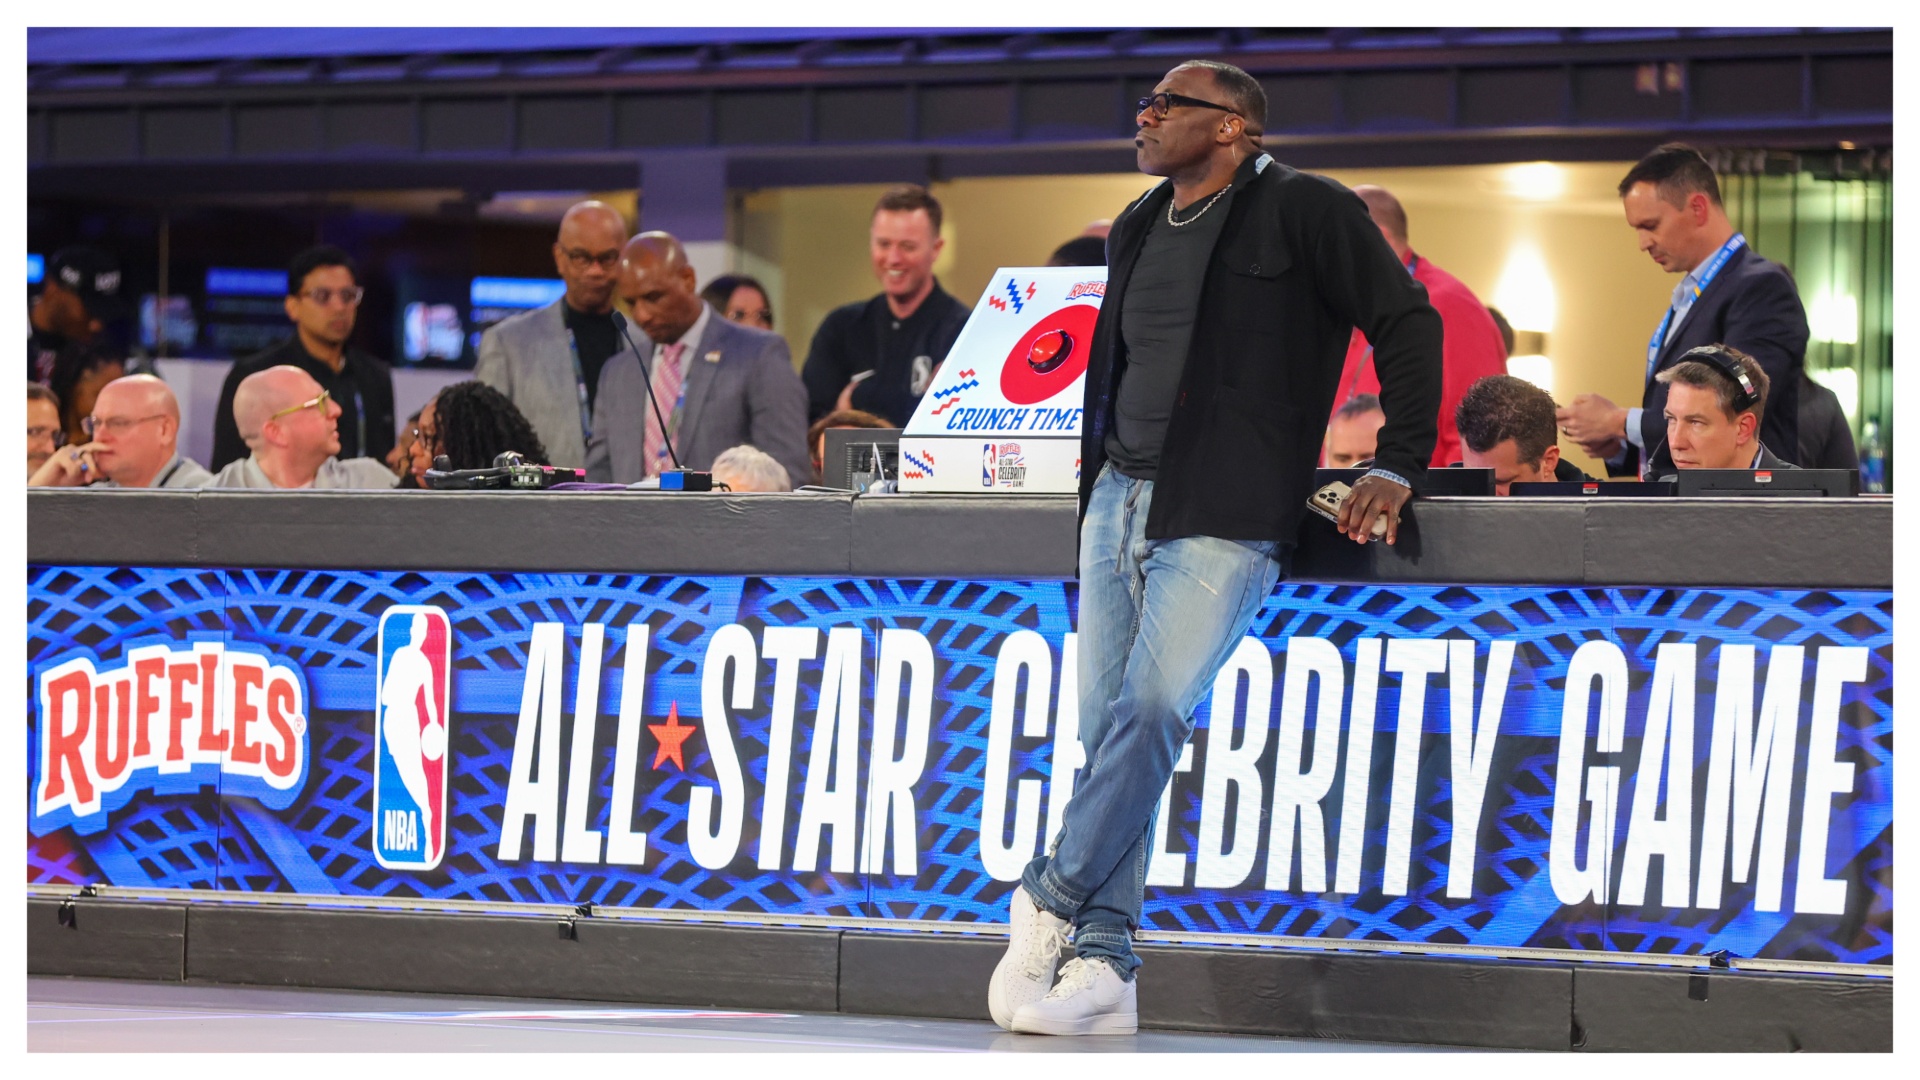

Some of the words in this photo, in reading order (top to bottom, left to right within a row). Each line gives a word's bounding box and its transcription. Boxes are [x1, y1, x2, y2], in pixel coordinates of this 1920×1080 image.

[1069, 282, 1107, 297] RUFFLES
[946, 407, 1030, 431] CRUNCH
[1028, 408, 1083, 430] TIME
[999, 445, 1020, 455] RUFFLES
[998, 466, 1027, 480] CELEBRITY
[42, 653, 297, 806] RUFFLES
[498, 622, 650, 865] ALL
[687, 623, 935, 876] STAR
[979, 629, 1516, 899] CEBRITY
[1549, 640, 1869, 915] GAME
[384, 809, 419, 852] NBA
